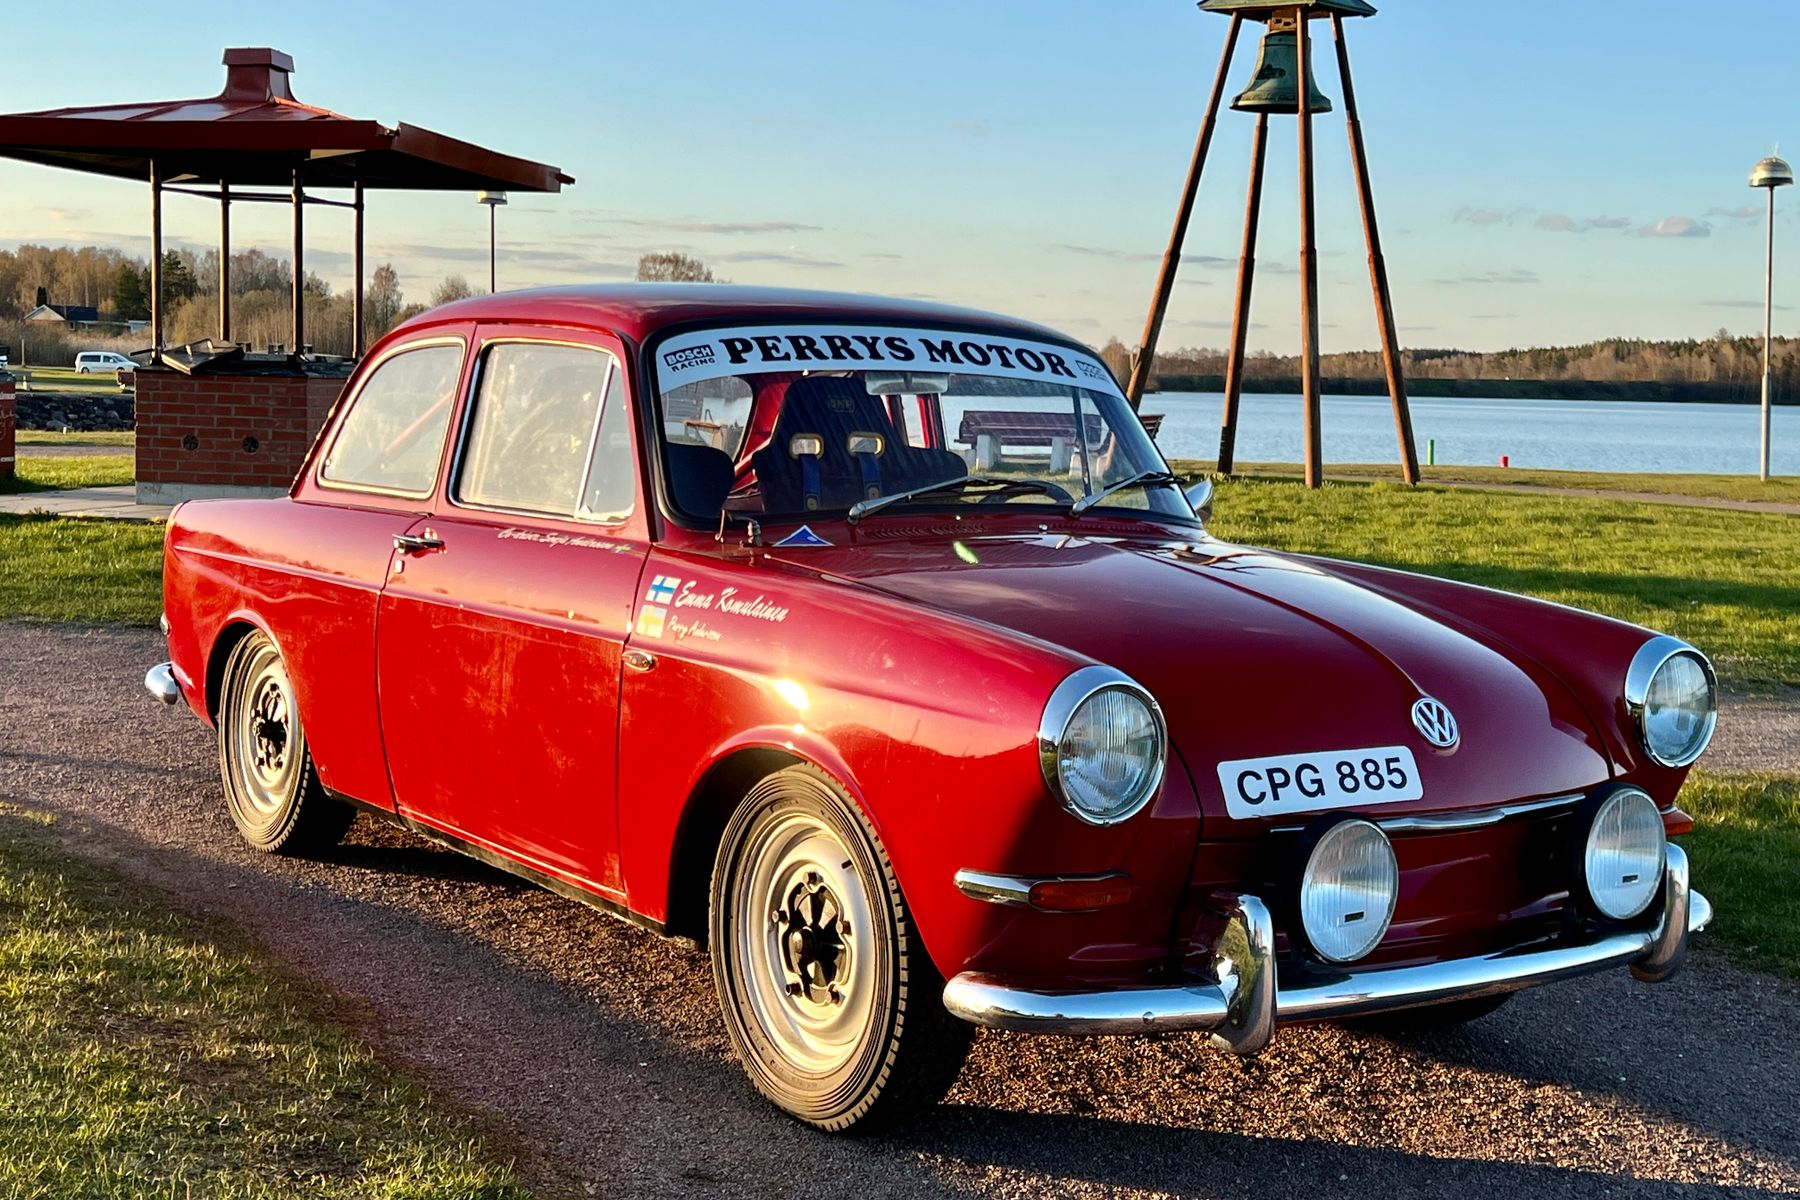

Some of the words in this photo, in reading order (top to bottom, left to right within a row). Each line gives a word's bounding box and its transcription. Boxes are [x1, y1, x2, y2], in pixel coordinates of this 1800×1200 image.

[665, 345, 713, 366] BOSCH
[671, 357, 716, 372] RACING
[718, 335, 916, 364] PERRYS
[918, 338, 1078, 379] MOTOR
[1236, 762, 1326, 805] CPG
[1335, 756, 1408, 794] 885
